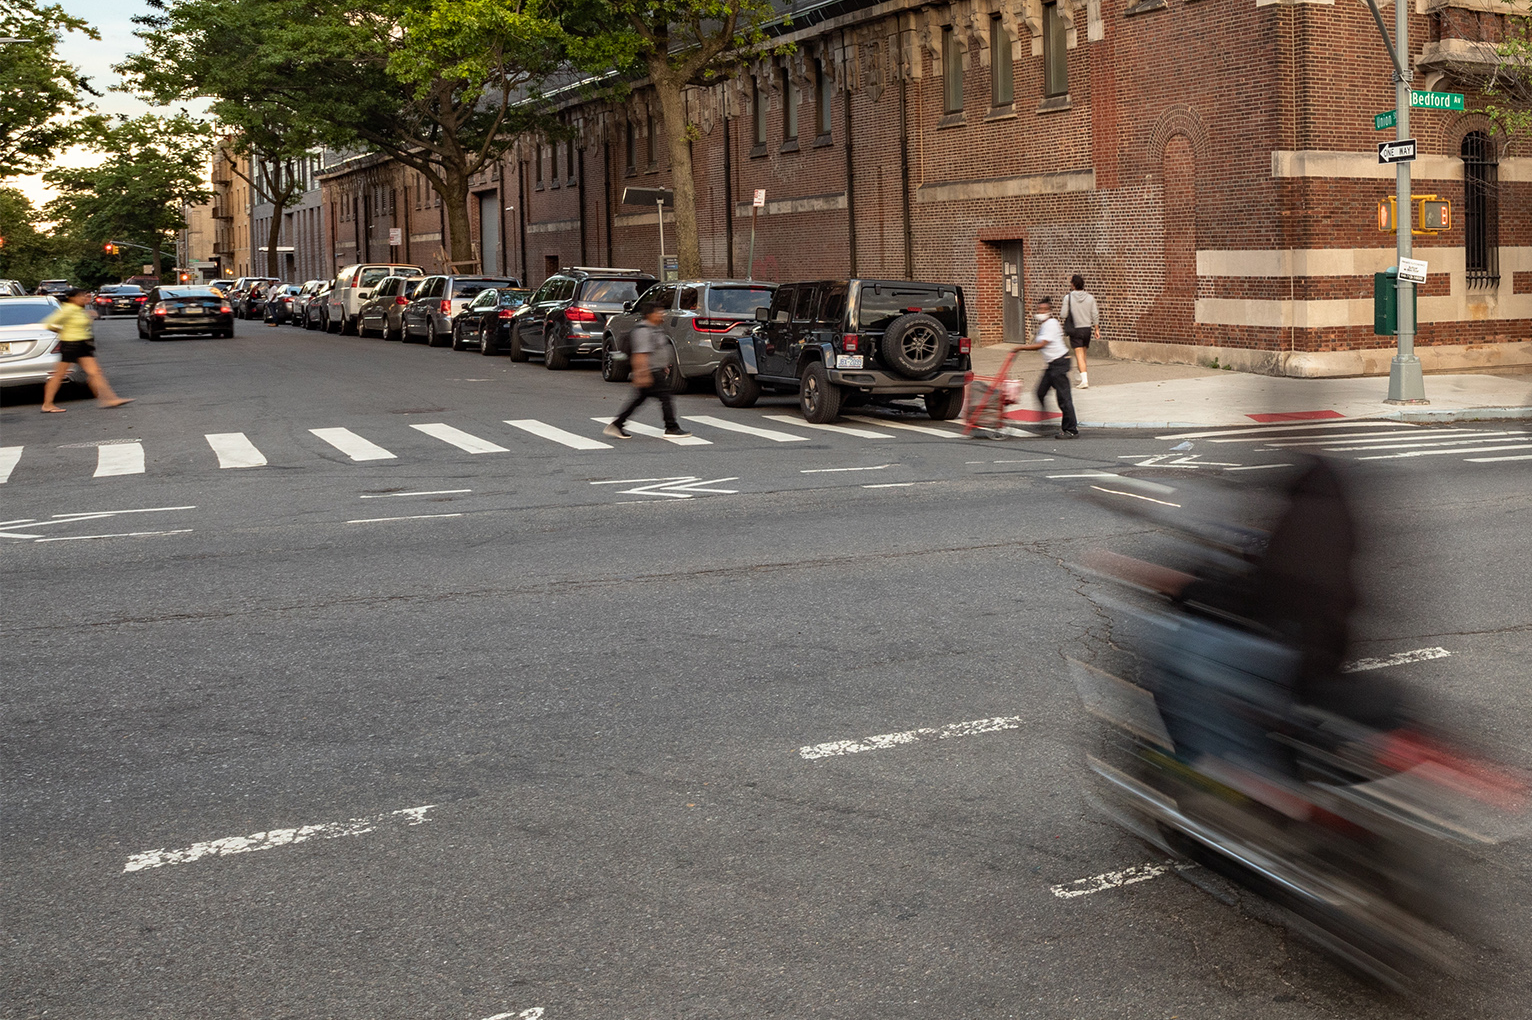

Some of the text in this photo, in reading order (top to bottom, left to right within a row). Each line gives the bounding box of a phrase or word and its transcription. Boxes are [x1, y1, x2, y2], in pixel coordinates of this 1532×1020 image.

[1412, 92, 1462, 107] Bedford Av
[1376, 113, 1392, 128] Union
[1383, 146, 1412, 158] ONE WAY
